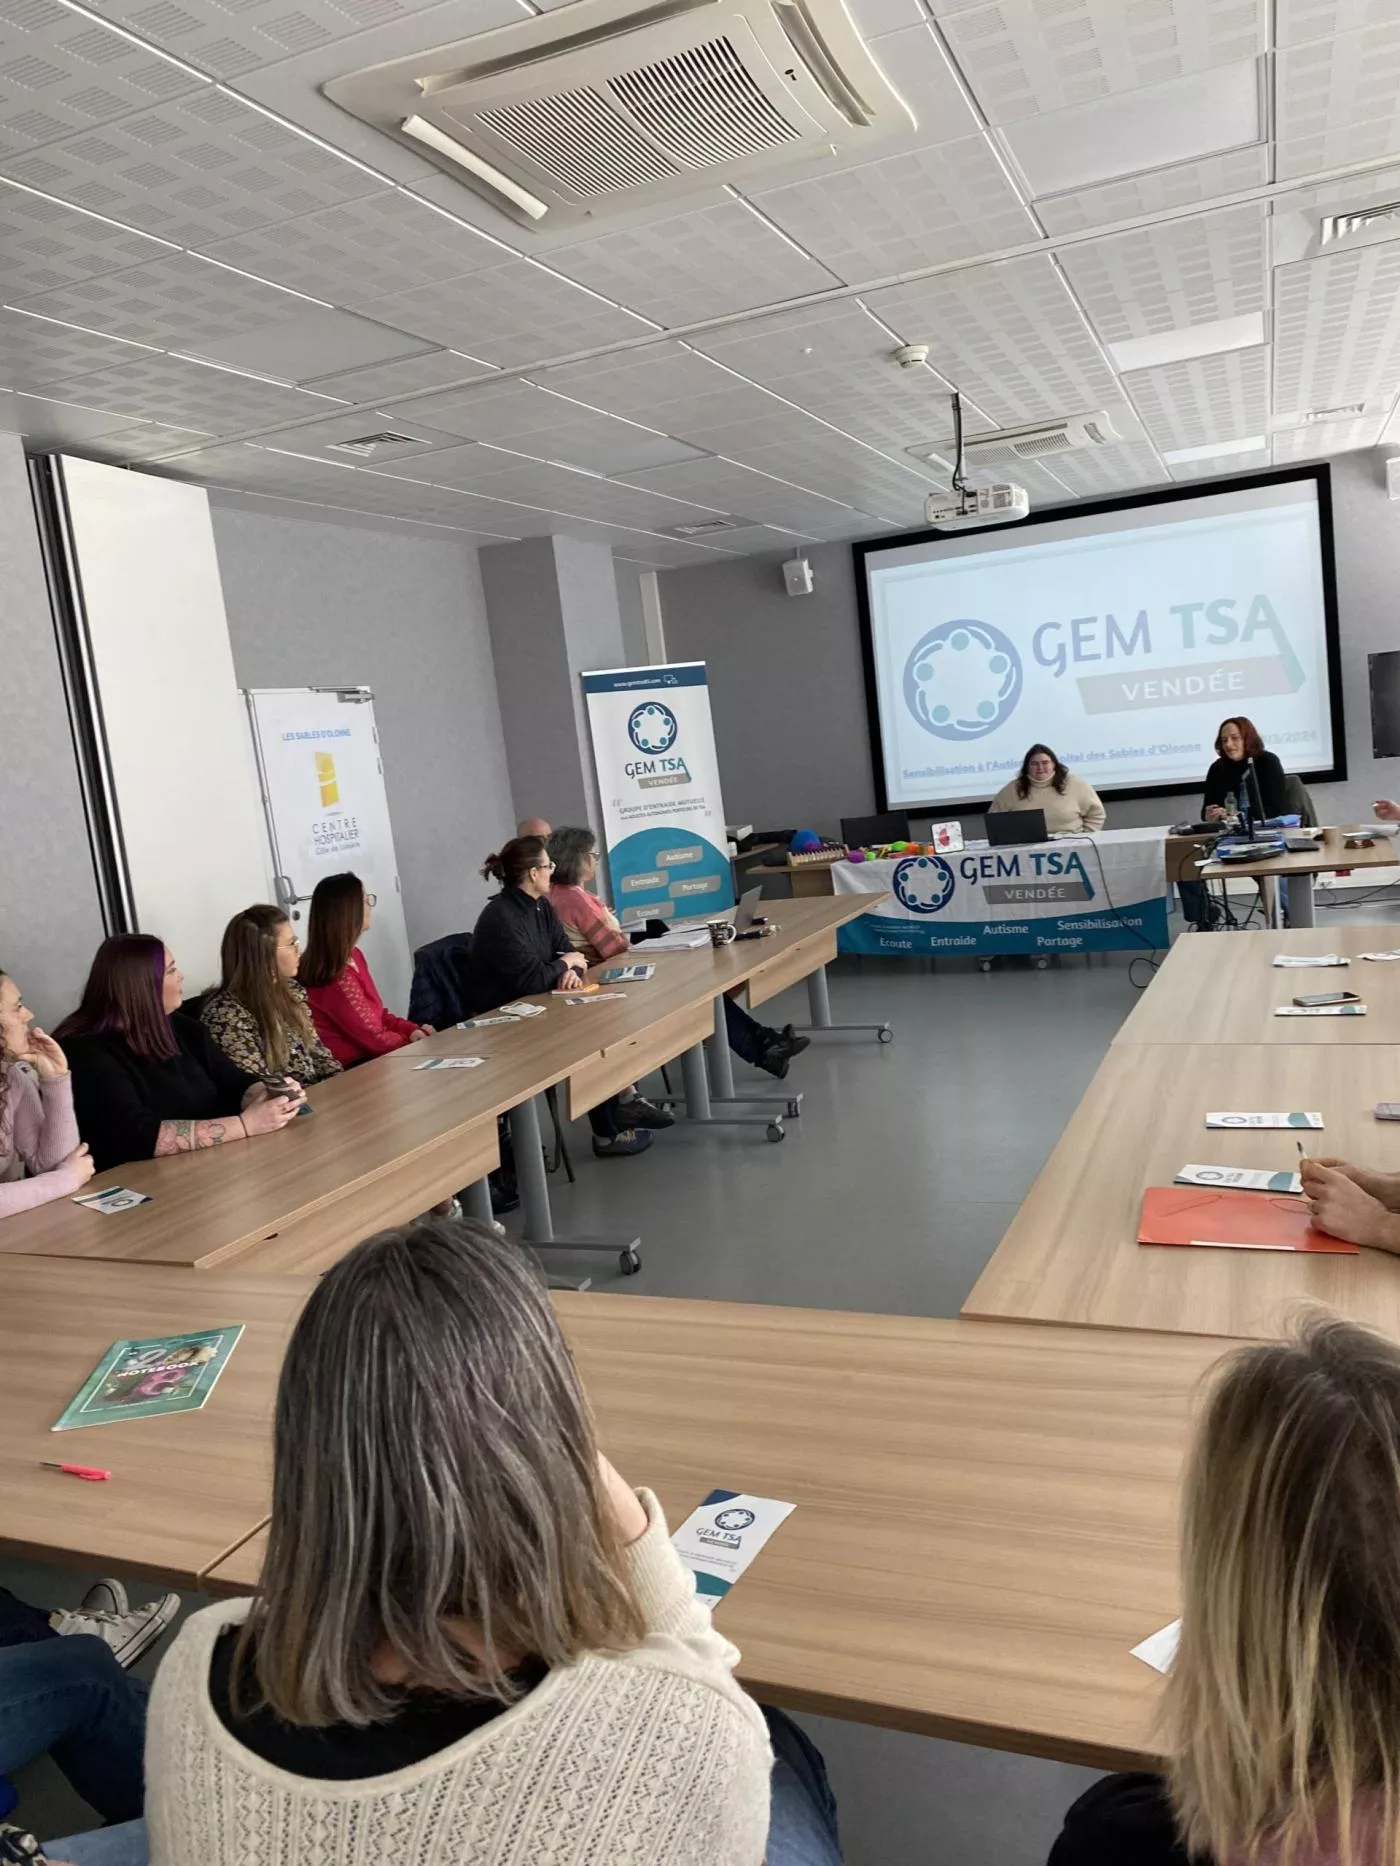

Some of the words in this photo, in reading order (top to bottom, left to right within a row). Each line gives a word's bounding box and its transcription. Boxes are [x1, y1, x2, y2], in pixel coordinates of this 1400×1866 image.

[1032, 609, 1152, 678] GEM
[1121, 669, 1245, 701] VENDÉE
[624, 760, 656, 779] GEM
[312, 817, 356, 834] CENTRE
[960, 854, 1020, 886] GEM
[1029, 851, 1096, 900] TSA
[1004, 886, 1066, 899] VENDÉE
[983, 923, 1029, 935] Autisme
[930, 935, 977, 947] Entraide
[1037, 936, 1083, 948] Partage
[116, 1362, 198, 1377] NOTEBOOK
[696, 1527, 720, 1538] GEM
